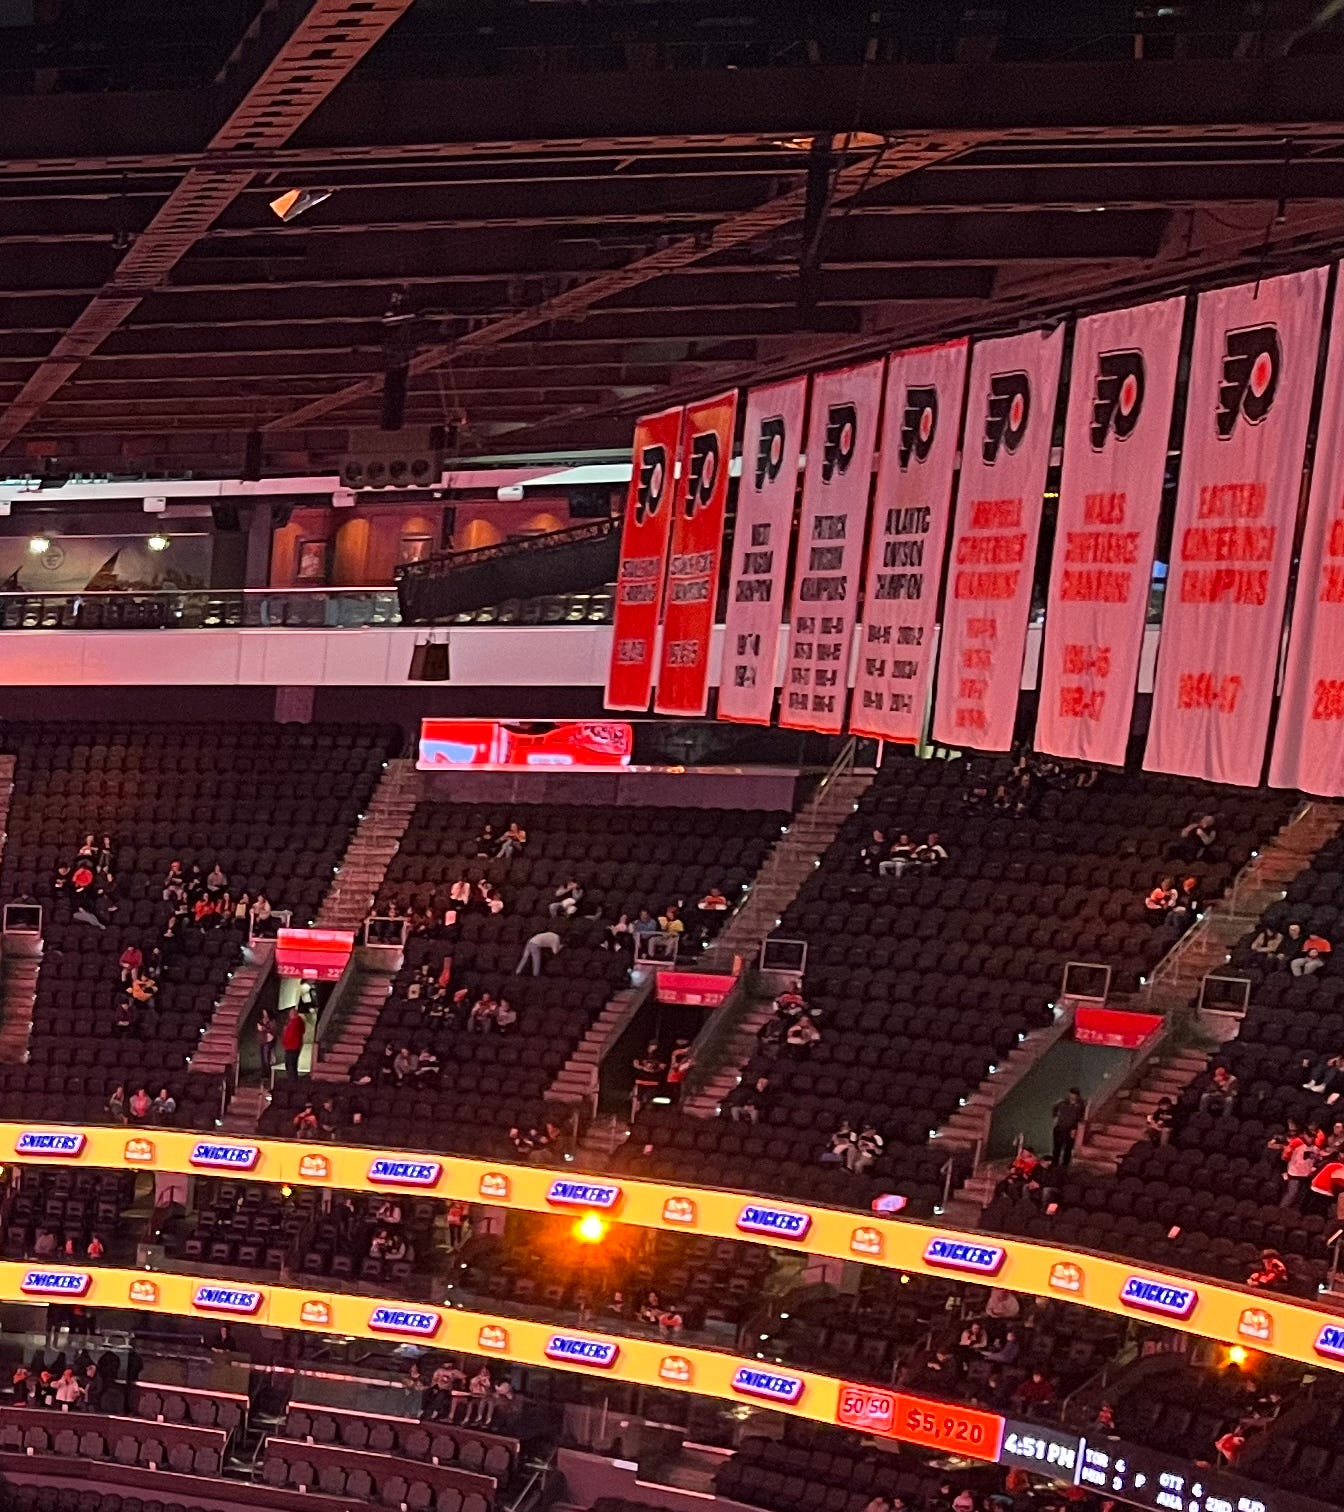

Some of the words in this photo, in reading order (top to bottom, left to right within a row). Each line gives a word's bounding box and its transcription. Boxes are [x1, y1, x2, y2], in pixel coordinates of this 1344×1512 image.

[20, 1134, 79, 1150] SNICKERS
[372, 1161, 434, 1180] SNICKERS
[742, 1207, 804, 1232] SNICKERS
[198, 1288, 255, 1307] SNICKERS
[1125, 1279, 1190, 1309] SNICKERS
[551, 1337, 610, 1360] SNICKERS
[842, 1395, 891, 1417] 50/50
[906, 1407, 984, 1446] $5,920
[1004, 1432, 1046, 1462] 4:51
[1046, 1441, 1077, 1470] PM
